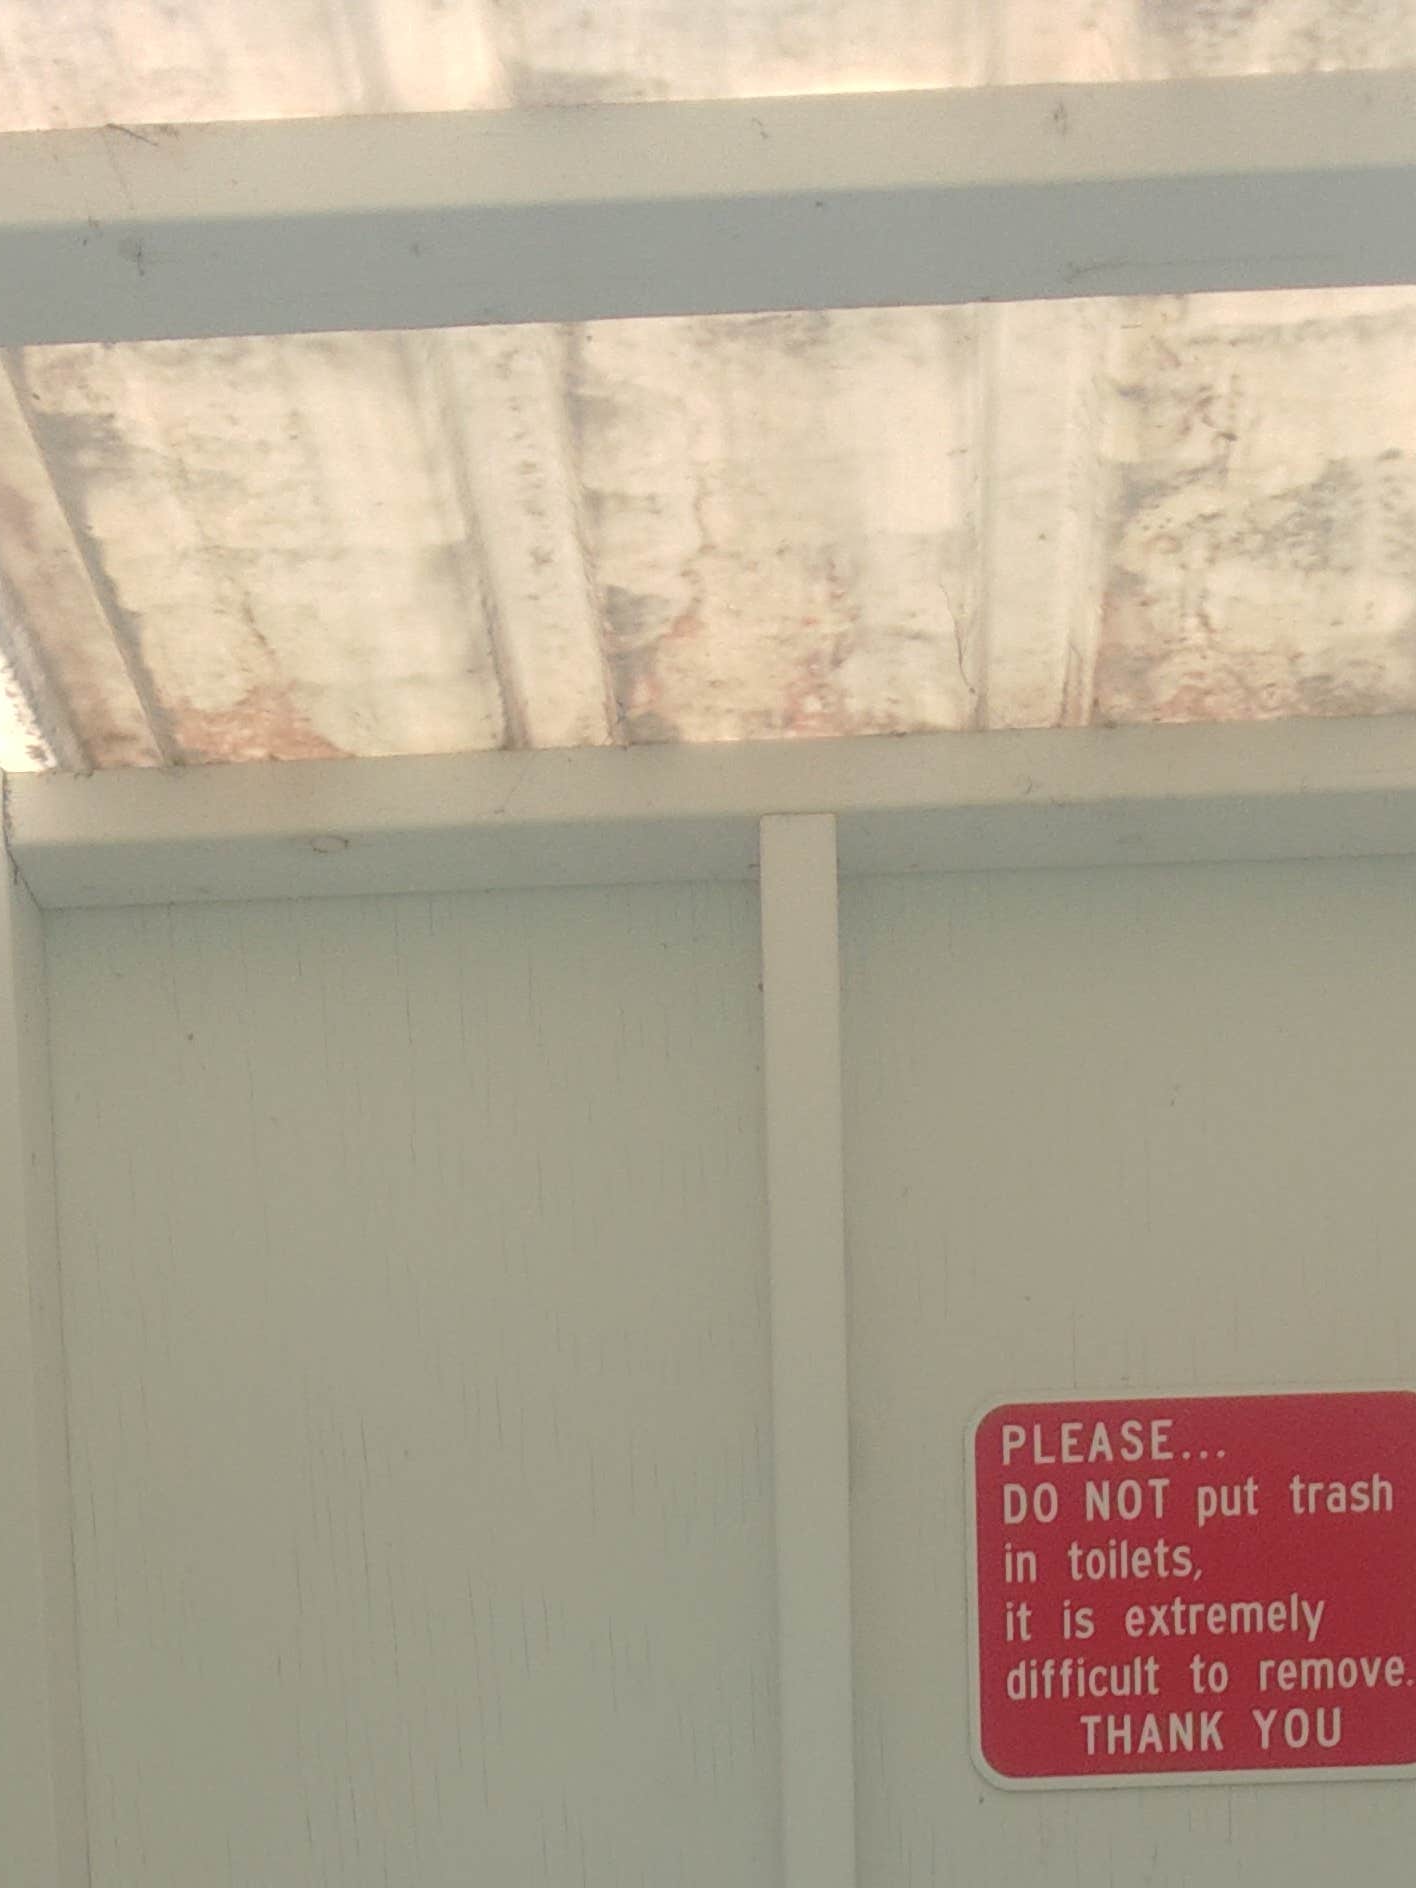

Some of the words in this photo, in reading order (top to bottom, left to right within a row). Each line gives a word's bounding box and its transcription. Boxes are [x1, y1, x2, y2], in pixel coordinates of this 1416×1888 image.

[1002, 1419, 1225, 1466] PLEASE...
[1002, 1482, 1059, 1524] DO
[1084, 1478, 1170, 1521] NOT
[1196, 1477, 1259, 1527] put
[1289, 1473, 1393, 1514] trash
[1004, 1542, 1038, 1583] in
[1067, 1538, 1203, 1581] toilets,
[1005, 1601, 1032, 1641] it
[1062, 1599, 1095, 1640] is
[1124, 1593, 1325, 1642] extremely
[1006, 1656, 1160, 1700] difficult
[1189, 1654, 1229, 1694] to
[1259, 1656, 1414, 1691] remove.
[1080, 1711, 1225, 1755] THANK
[1252, 1707, 1342, 1750] YOU
